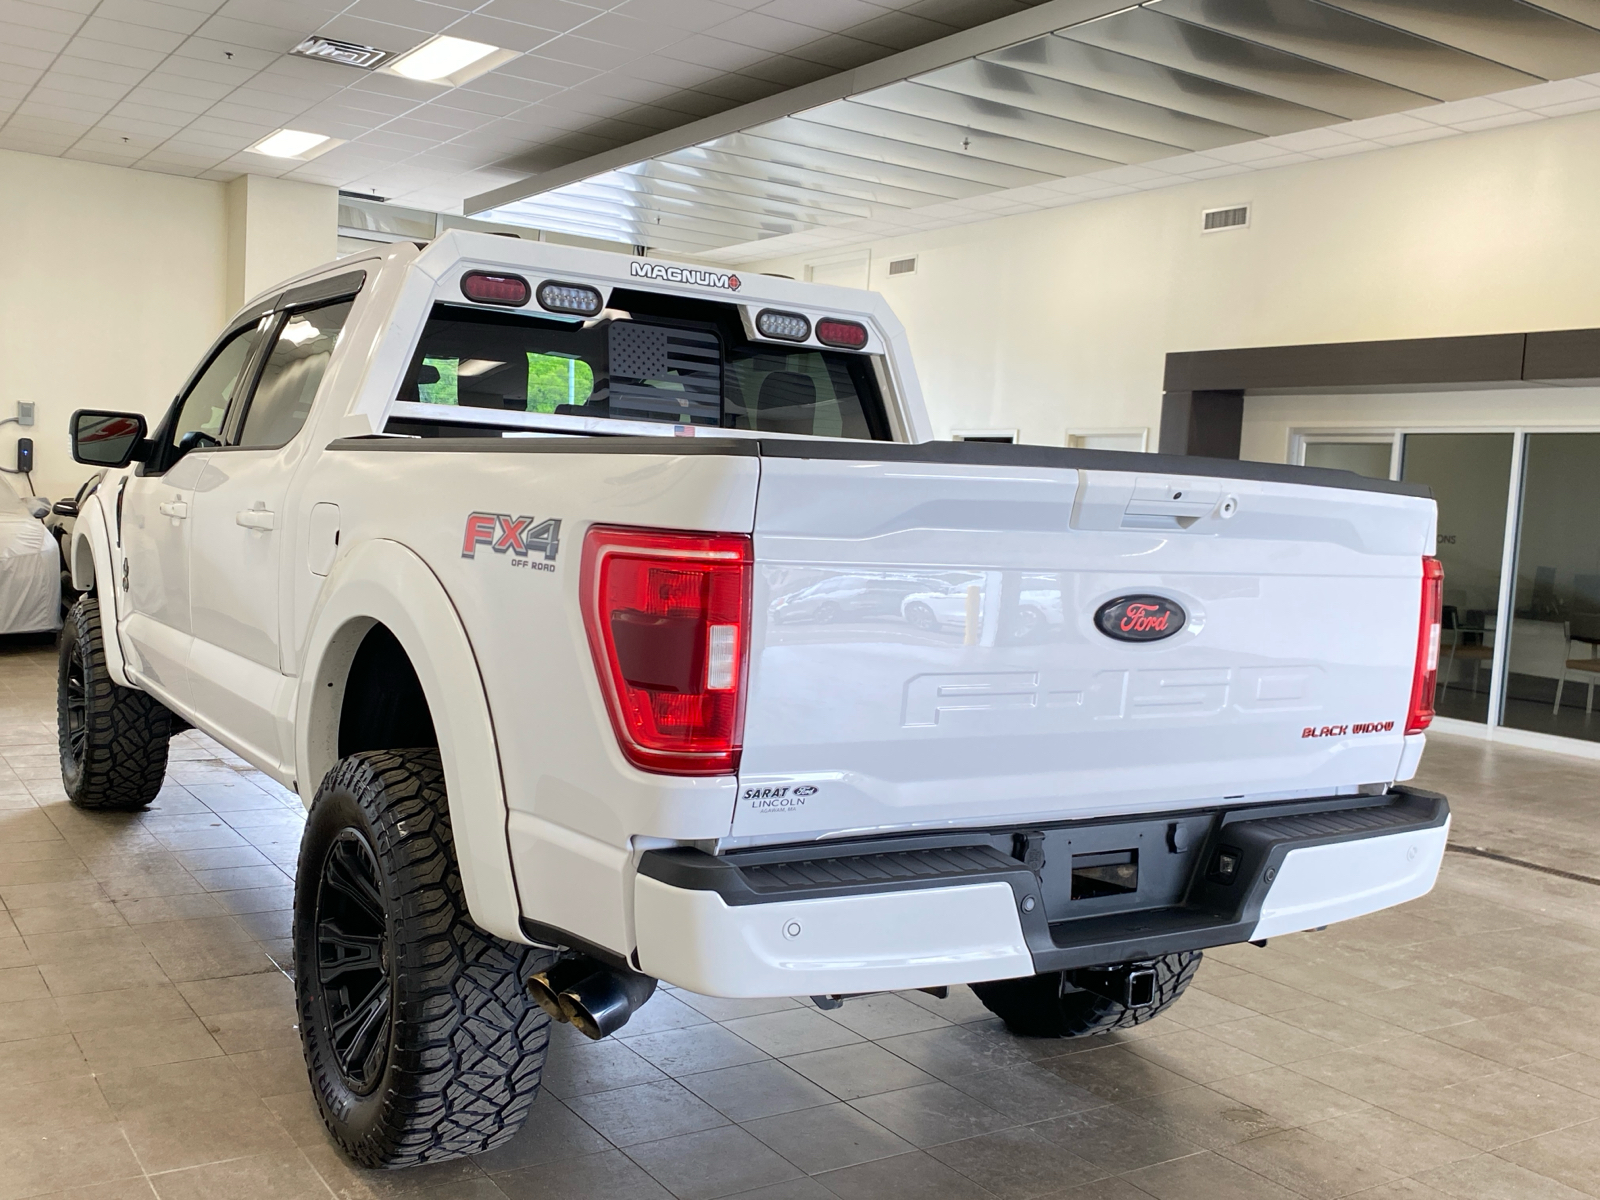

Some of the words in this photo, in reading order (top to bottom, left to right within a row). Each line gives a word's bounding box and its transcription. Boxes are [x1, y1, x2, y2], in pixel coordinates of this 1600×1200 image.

[631, 262, 729, 289] MAGNUM
[461, 511, 562, 561] FX4
[511, 559, 529, 568] OFF
[531, 561, 555, 572] ROAD
[1120, 603, 1170, 631] Ford
[902, 665, 1327, 728] F-150
[1301, 725, 1348, 738] BLACK
[1352, 721, 1394, 734] WIDOW
[744, 787, 790, 799] SARAT
[752, 798, 805, 808] LINCOLN
[299, 976, 350, 1123] TERRAMAX
